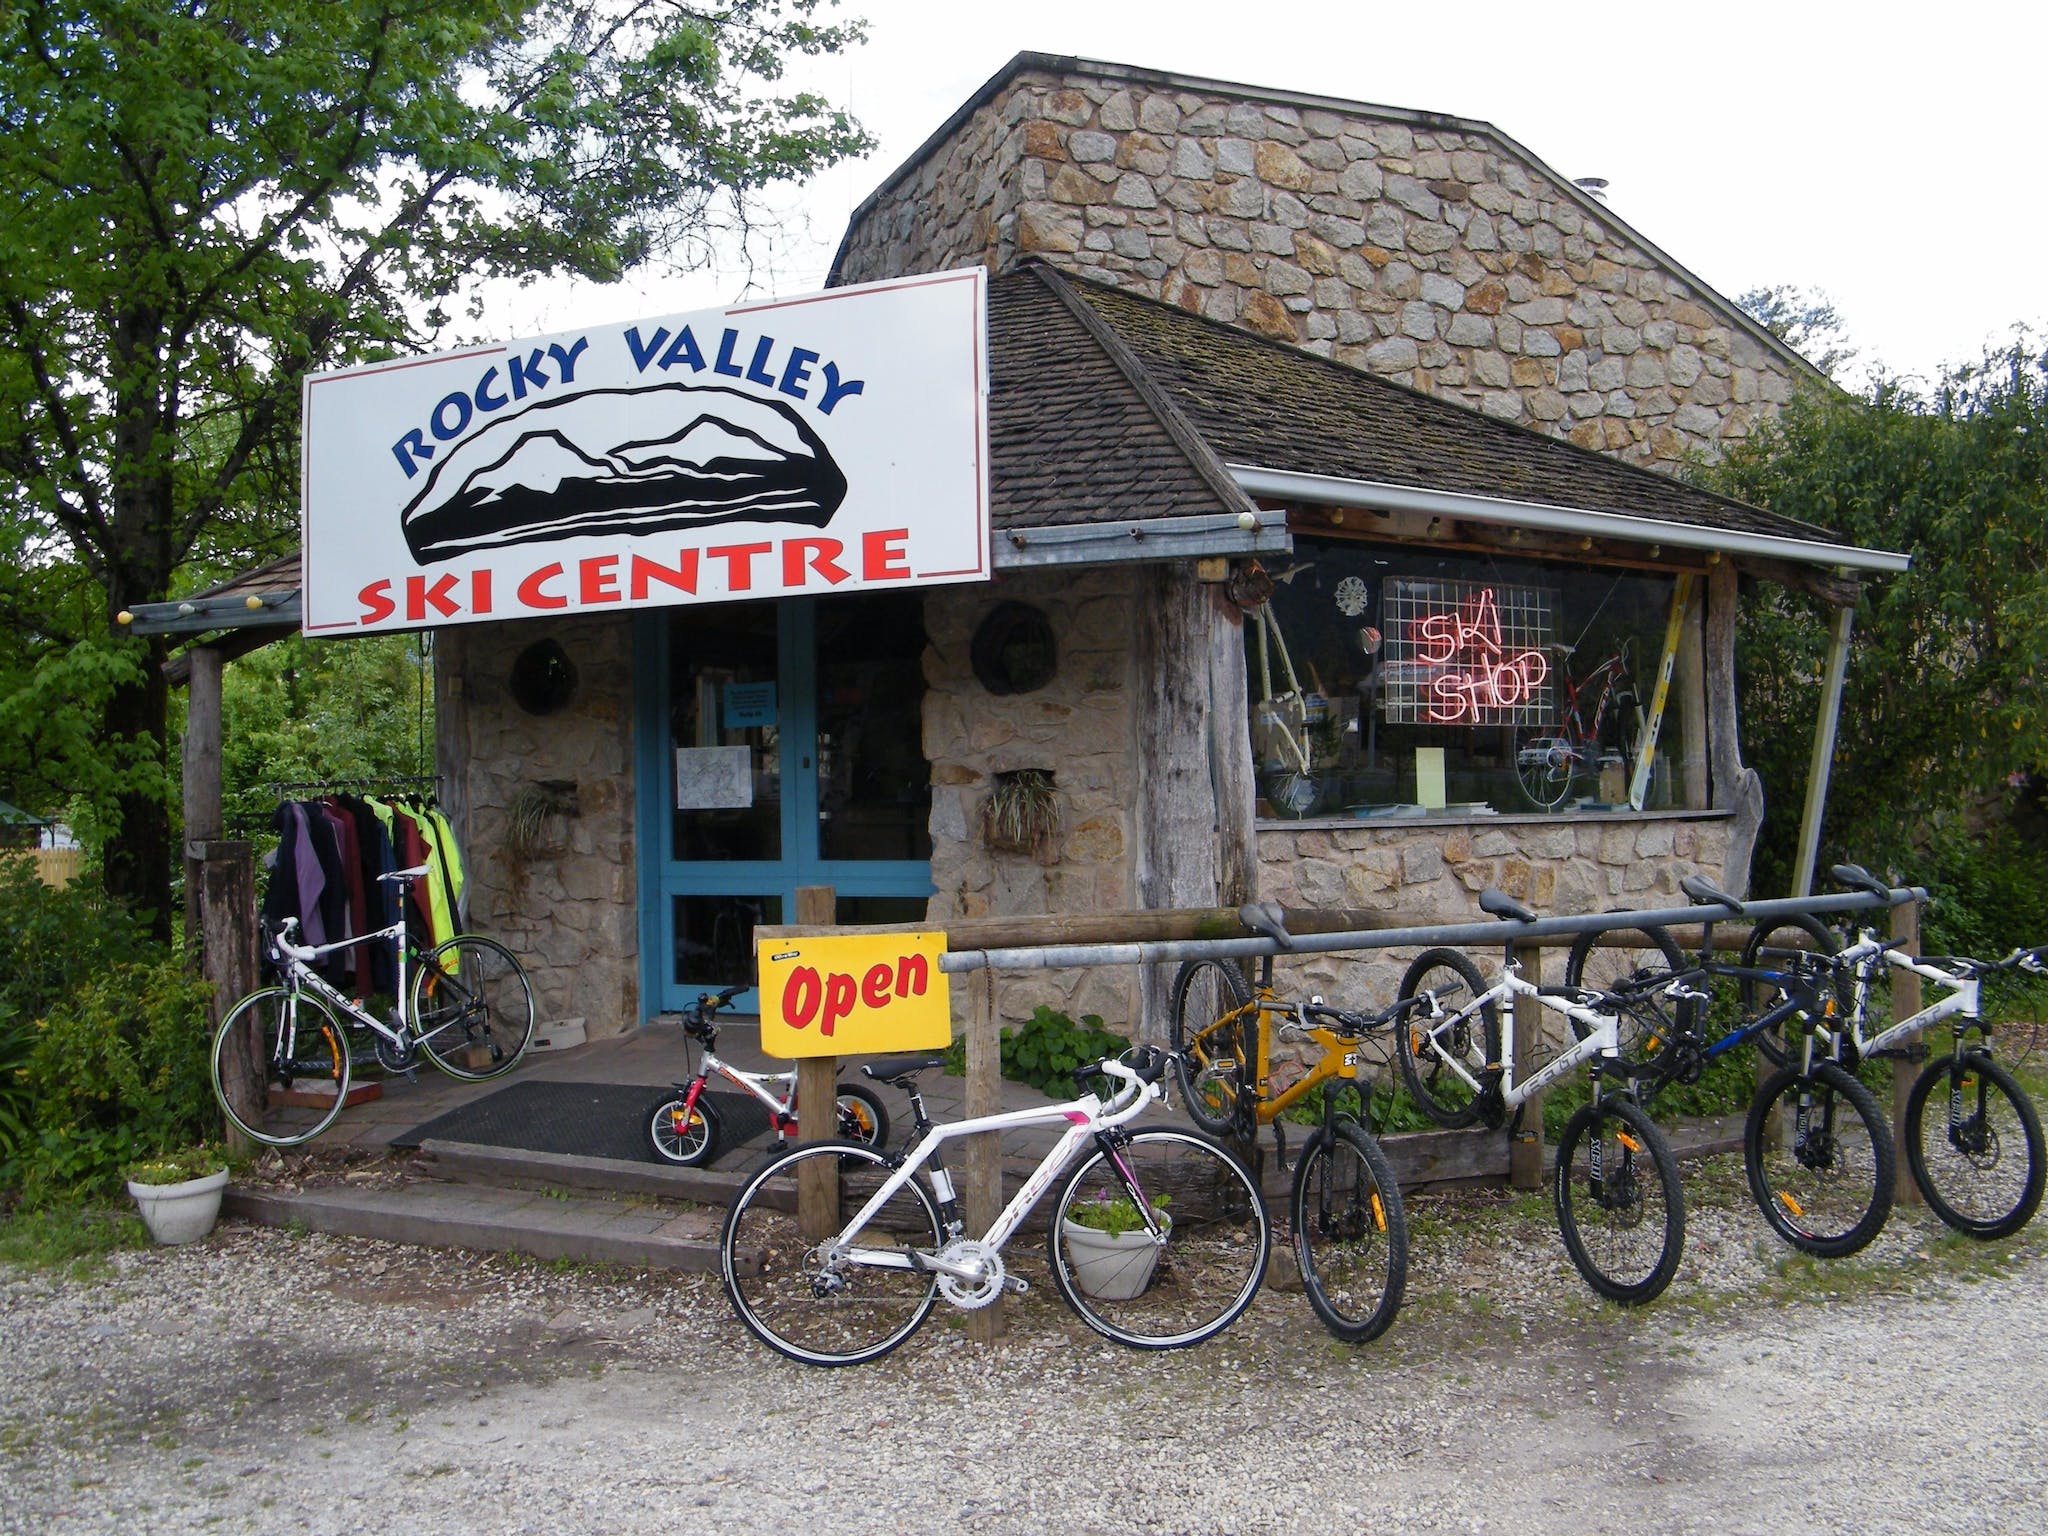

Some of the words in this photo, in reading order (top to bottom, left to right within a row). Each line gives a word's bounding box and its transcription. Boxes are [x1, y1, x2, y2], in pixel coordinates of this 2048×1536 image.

[391, 336, 589, 479] ROCKY
[624, 324, 864, 415] VALLEY
[357, 569, 492, 626] SKI
[517, 528, 912, 610] CENTRE
[1419, 588, 1502, 663] SKI
[1428, 651, 1547, 723] SHOP
[782, 953, 928, 1037] Open
